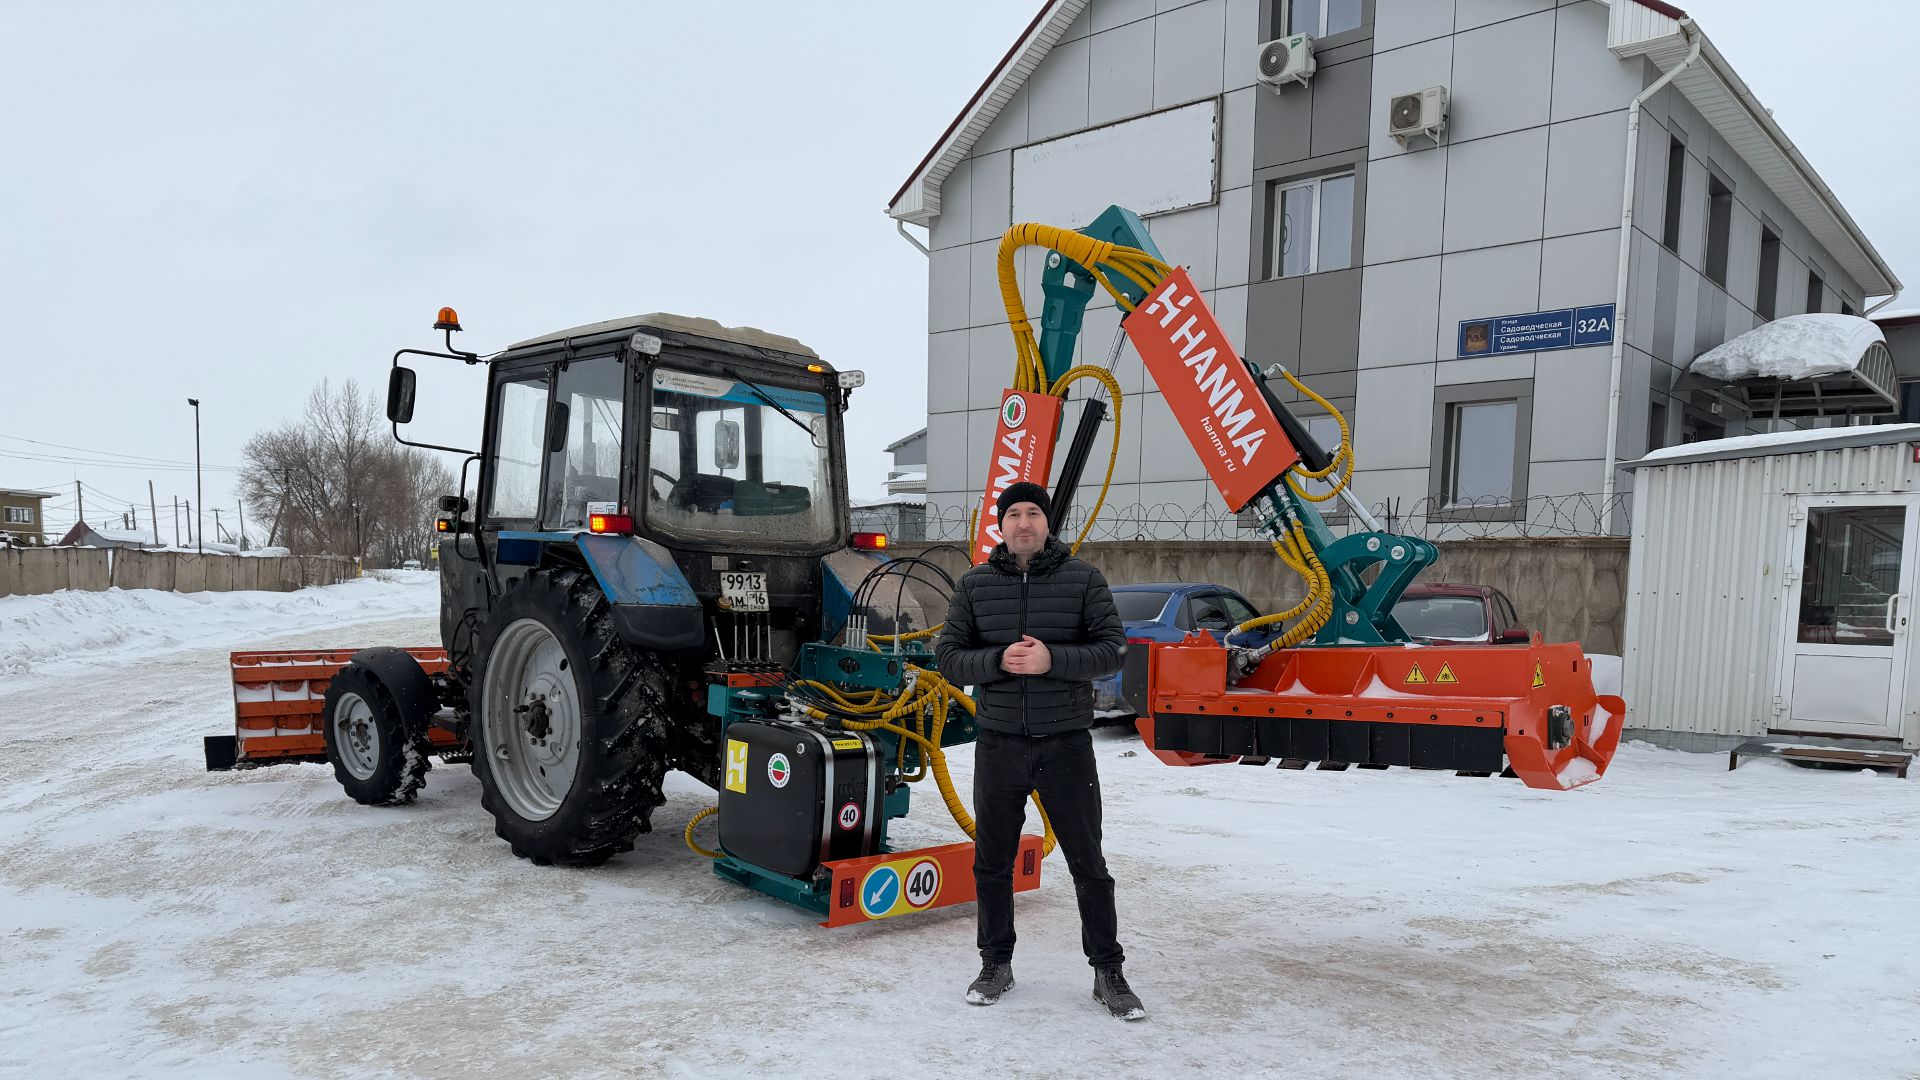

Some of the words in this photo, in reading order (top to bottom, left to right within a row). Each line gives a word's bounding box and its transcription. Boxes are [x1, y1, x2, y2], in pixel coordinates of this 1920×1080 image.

[1500, 321, 1563, 334] Садоводческая
[1500, 332, 1562, 344] Садоводческая
[1169, 314, 1267, 467] HANMA
[727, 574, 761, 590] 9913
[753, 592, 765, 605] 16
[842, 809, 856, 823] 40
[909, 869, 935, 898] 40
